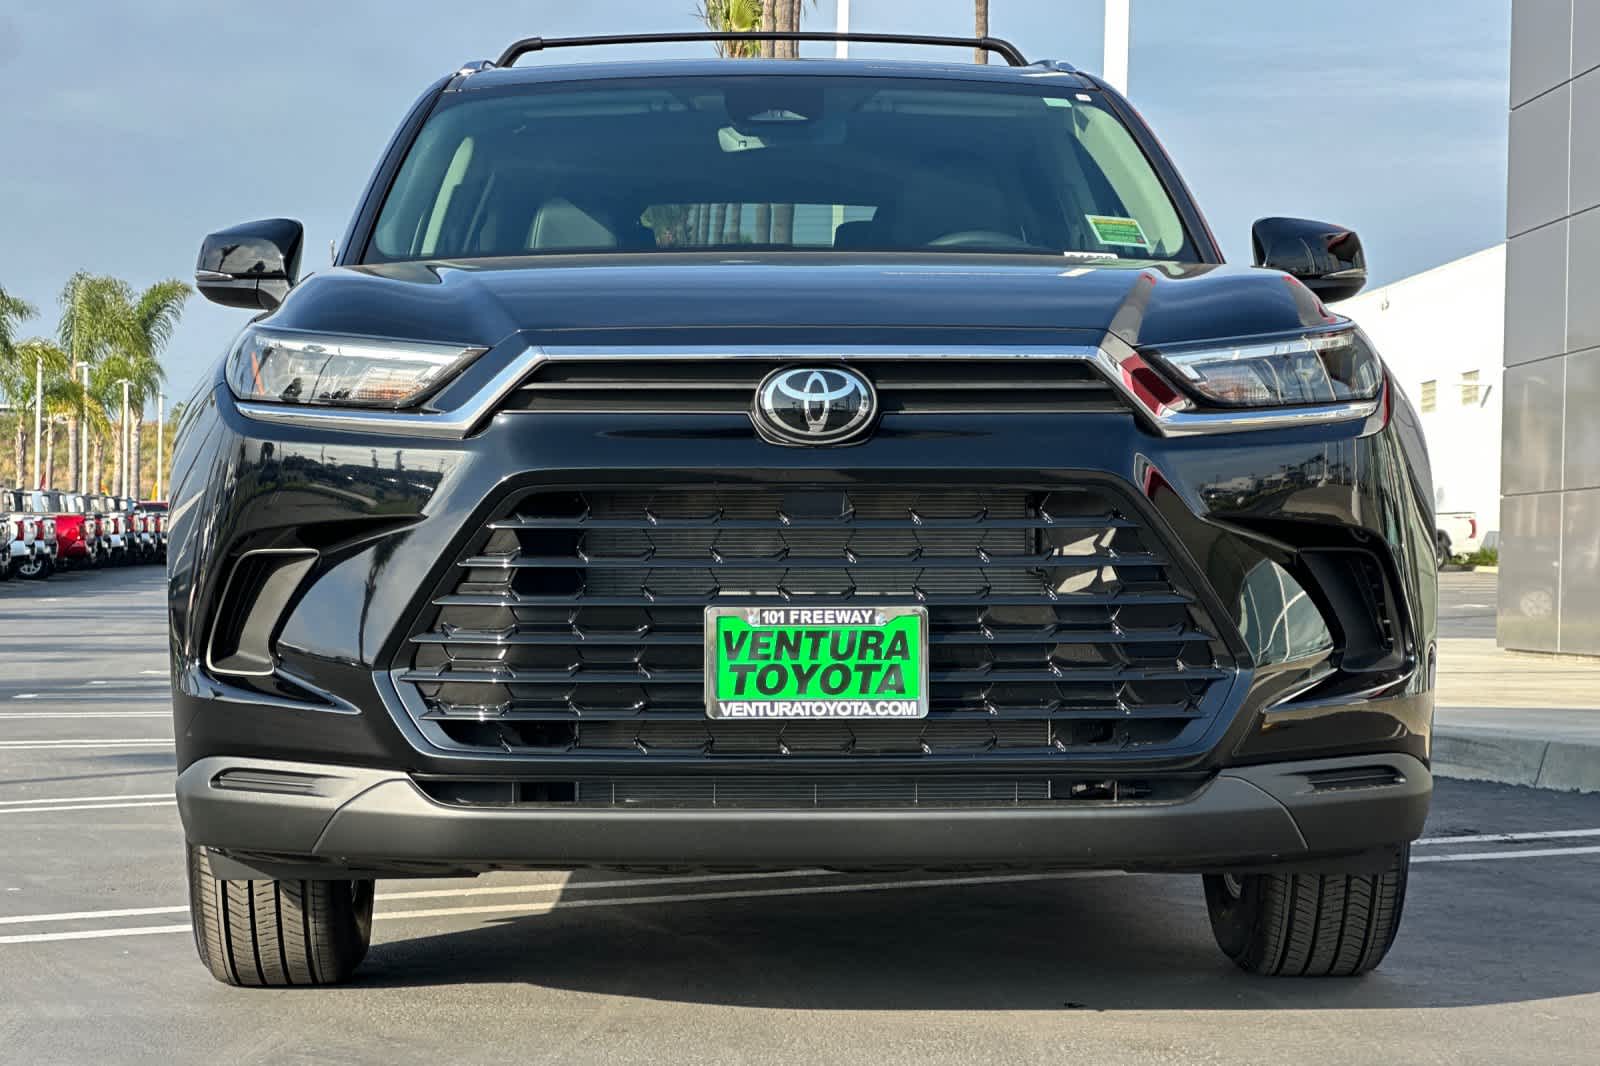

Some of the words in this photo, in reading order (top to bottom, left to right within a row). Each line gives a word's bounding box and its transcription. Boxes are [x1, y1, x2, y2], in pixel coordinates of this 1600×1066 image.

[762, 610, 785, 624] 101
[790, 610, 873, 624] FREEWAY
[723, 630, 910, 661] VENTURA
[729, 663, 906, 695] TOYOTA
[720, 702, 917, 717] VENTURATOYOTA.COM
